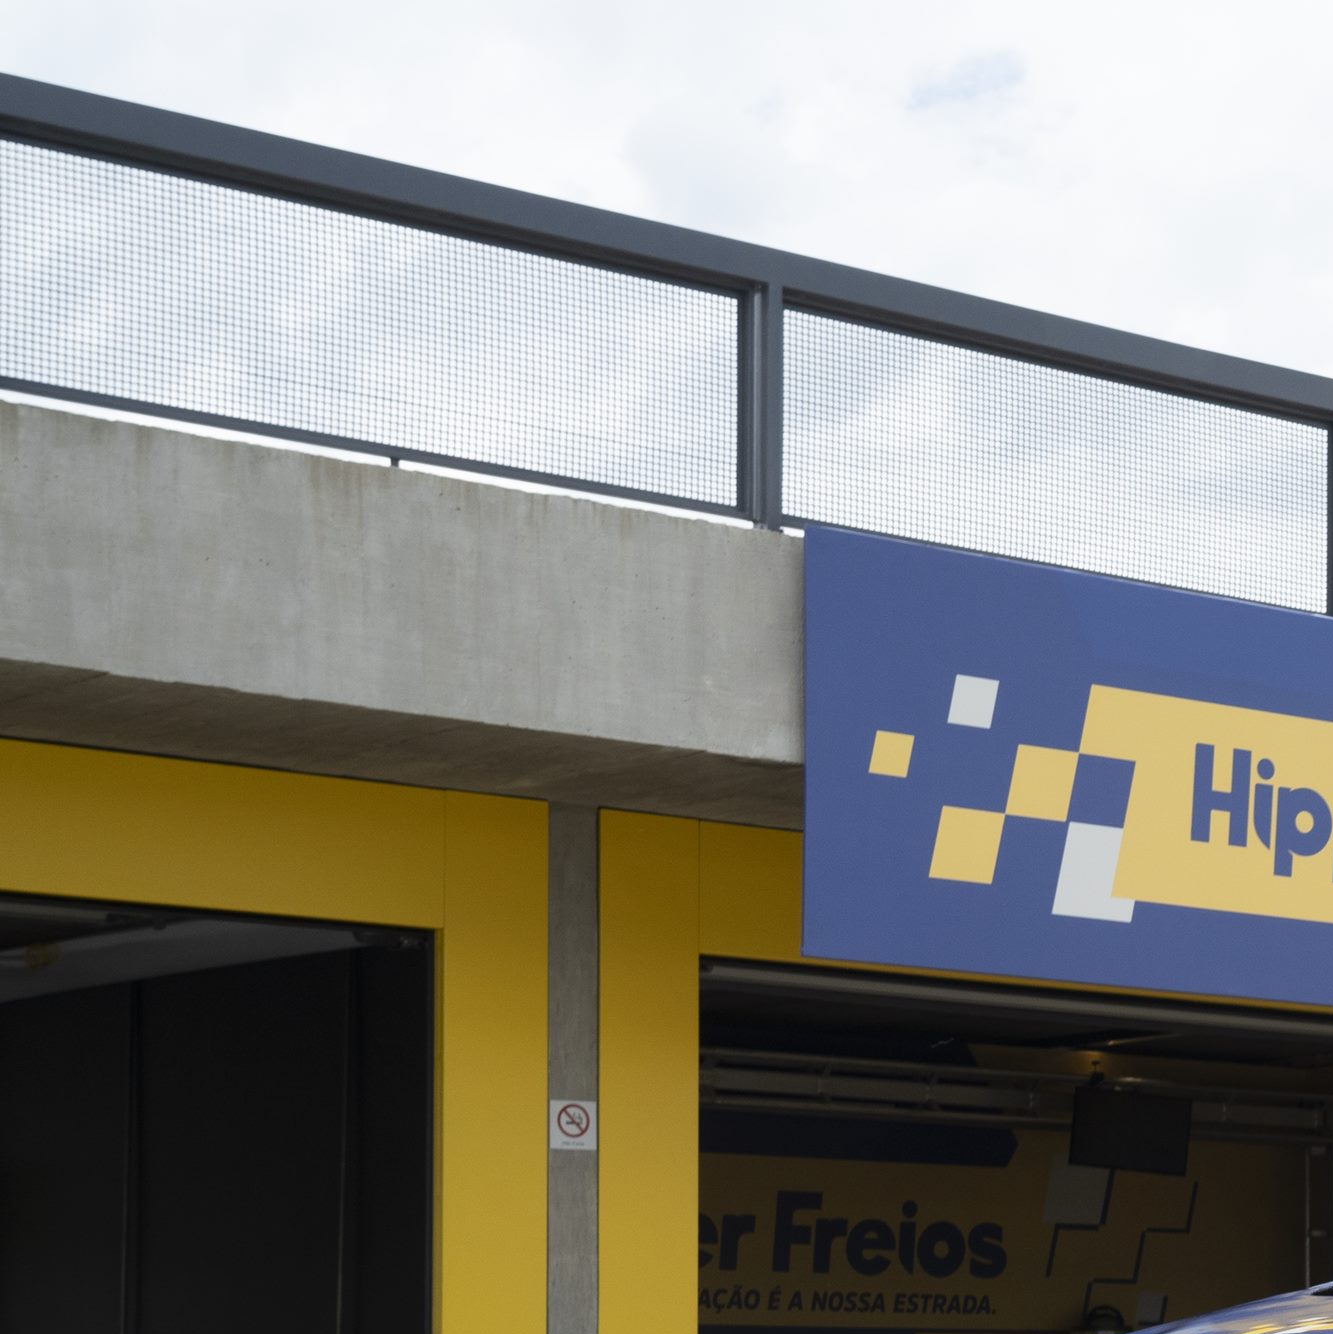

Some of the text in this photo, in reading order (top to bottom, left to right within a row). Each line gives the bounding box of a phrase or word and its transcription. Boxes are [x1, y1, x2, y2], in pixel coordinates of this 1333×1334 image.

[771, 1189, 1008, 1279] Freios
[767, 1285, 782, 1311] É
[787, 1290, 803, 1311] A
[811, 1291, 885, 1313] NOSSA
[893, 1293, 996, 1315] ESTRADA.
